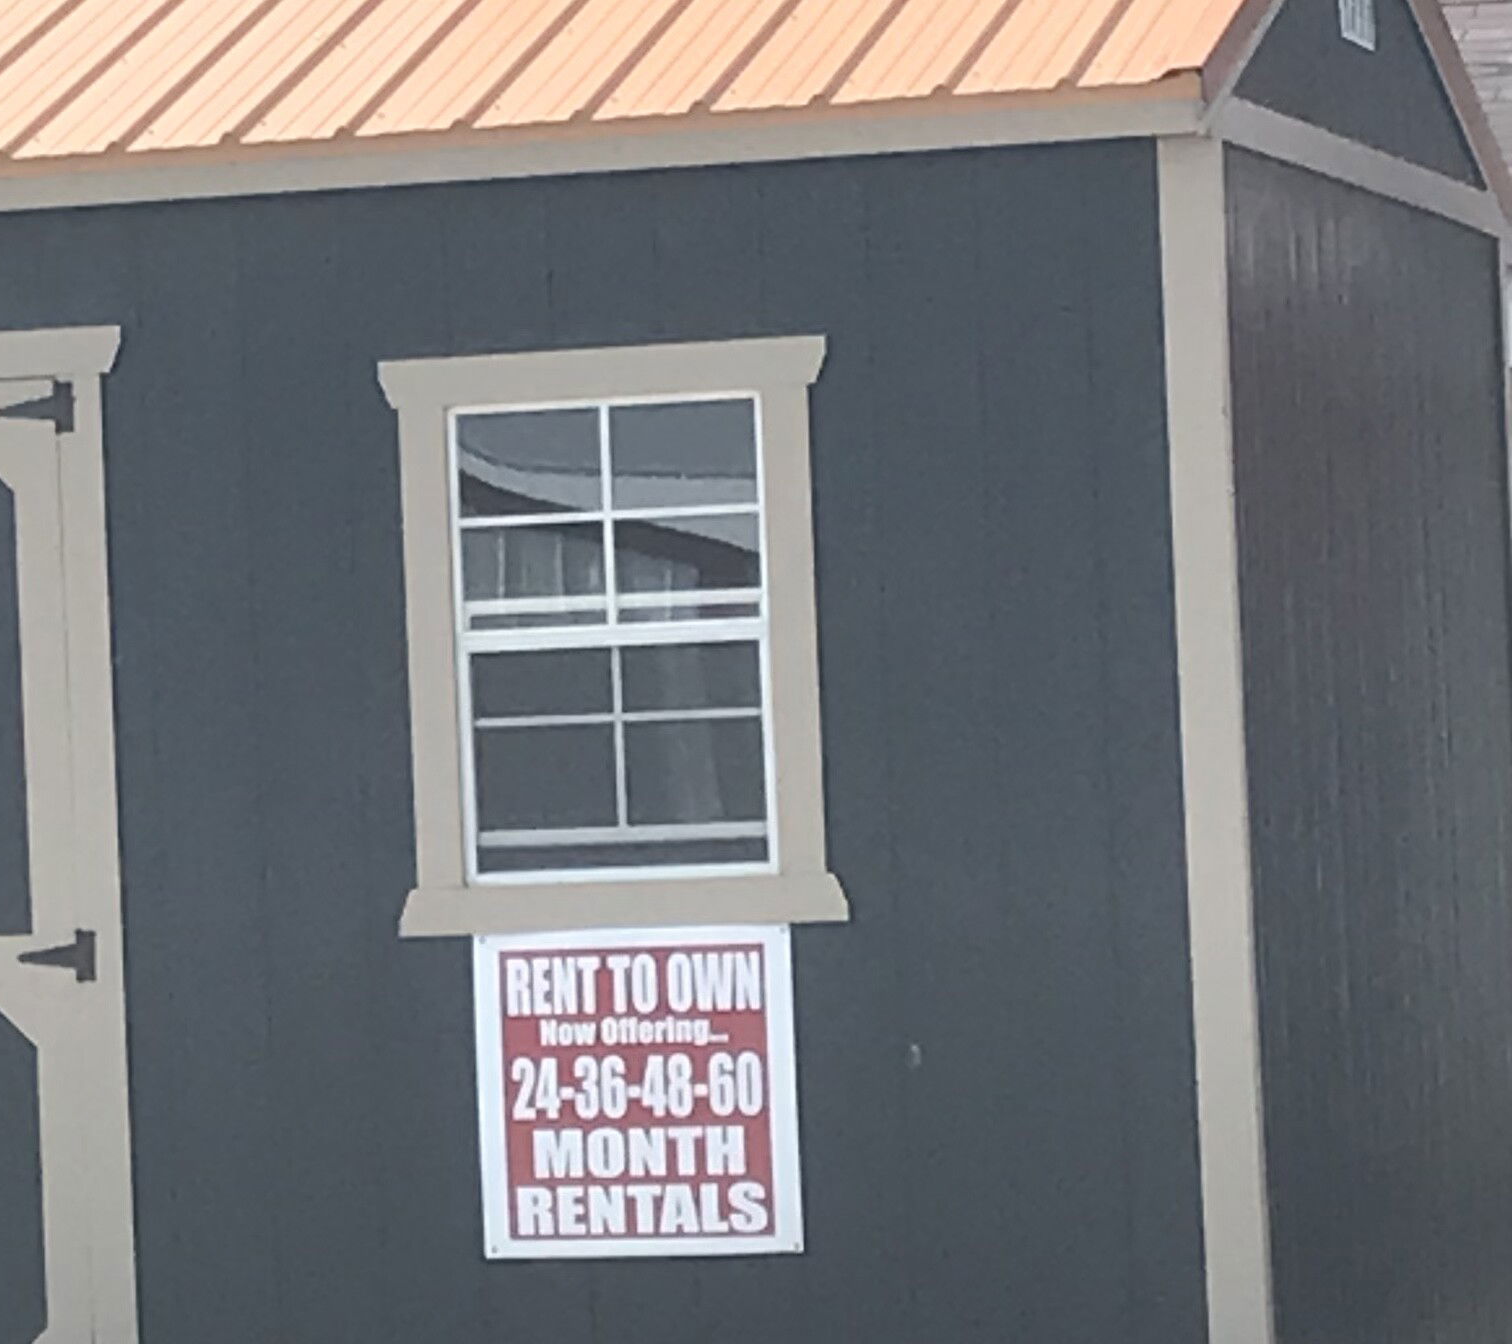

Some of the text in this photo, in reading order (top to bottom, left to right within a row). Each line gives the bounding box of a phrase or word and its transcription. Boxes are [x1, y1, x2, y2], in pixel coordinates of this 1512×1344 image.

[505, 950, 762, 1016] RENT TO OWN
[540, 1019, 596, 1046] Now
[510, 1051, 763, 1120] 24-36-48-60
[533, 1125, 746, 1179] MONTH
[516, 1181, 768, 1236] RENTALS
